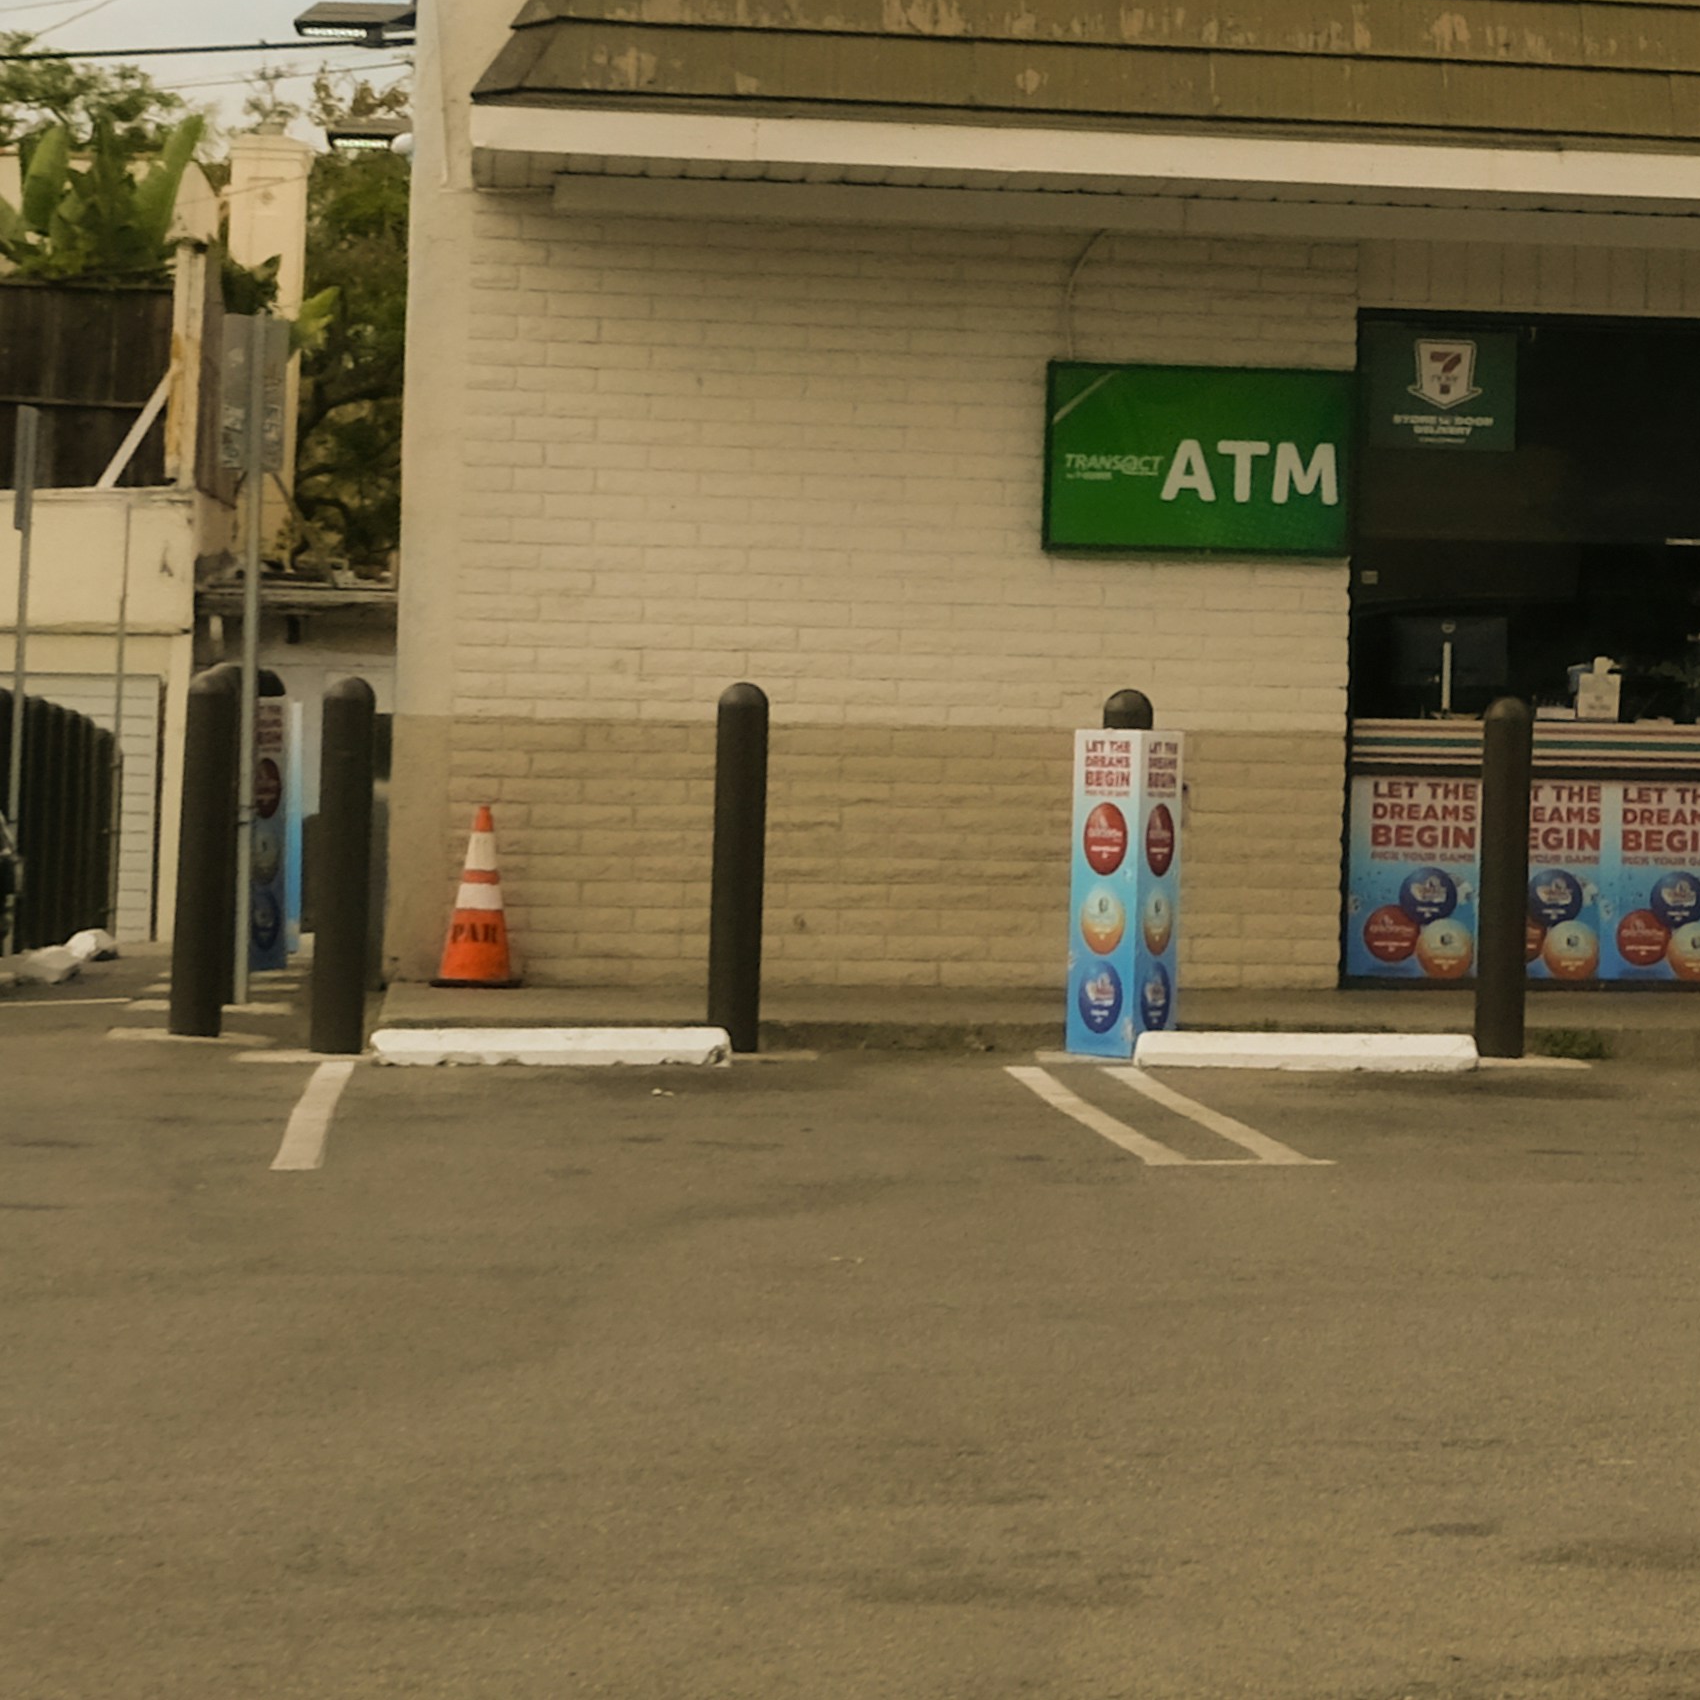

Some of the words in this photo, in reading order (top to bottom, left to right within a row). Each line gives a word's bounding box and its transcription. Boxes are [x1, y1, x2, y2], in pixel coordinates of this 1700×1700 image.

[1160, 438, 1338, 506] ATM
[1085, 770, 1130, 787] BEGIN
[1373, 781, 1419, 799] LET
[1427, 782, 1477, 801] THE
[1551, 785, 1600, 802] THE
[1623, 787, 1668, 804] LET
[1372, 803, 1476, 822] DREAMS
[1532, 806, 1600, 824] EAMS
[1371, 824, 1476, 849] BEGIN
[1529, 827, 1600, 851] EGIN
